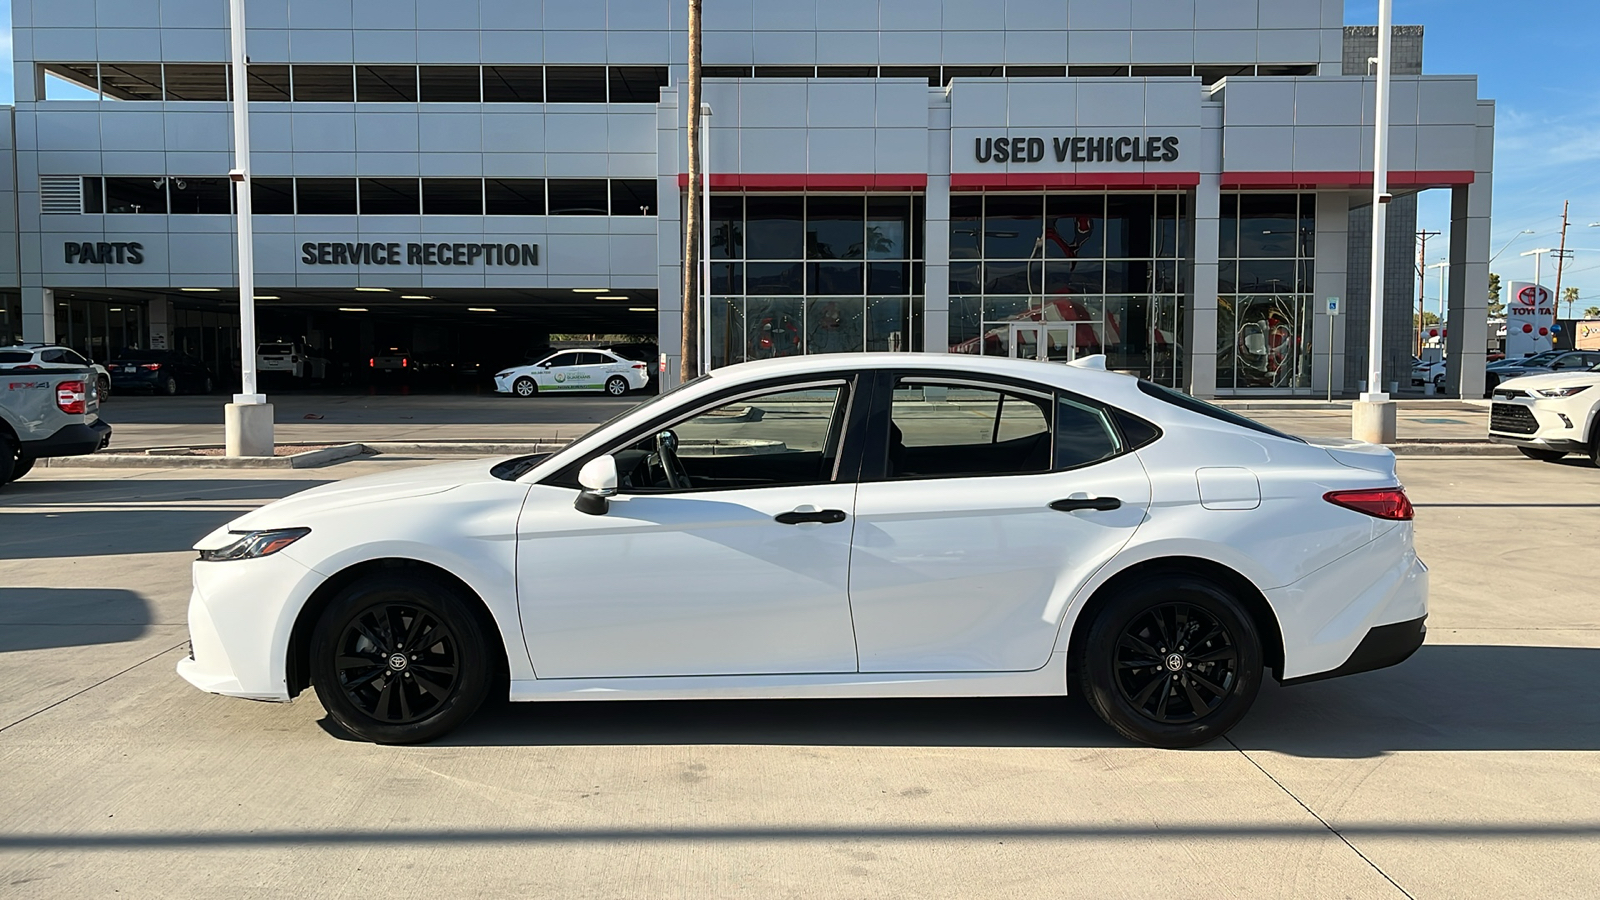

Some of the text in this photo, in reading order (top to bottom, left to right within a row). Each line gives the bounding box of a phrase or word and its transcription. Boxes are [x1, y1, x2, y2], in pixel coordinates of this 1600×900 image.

[975, 136, 1179, 163] USED VEHICLES
[64, 242, 144, 264] PARTS
[301, 242, 539, 266] SERVICE RECEPTION
